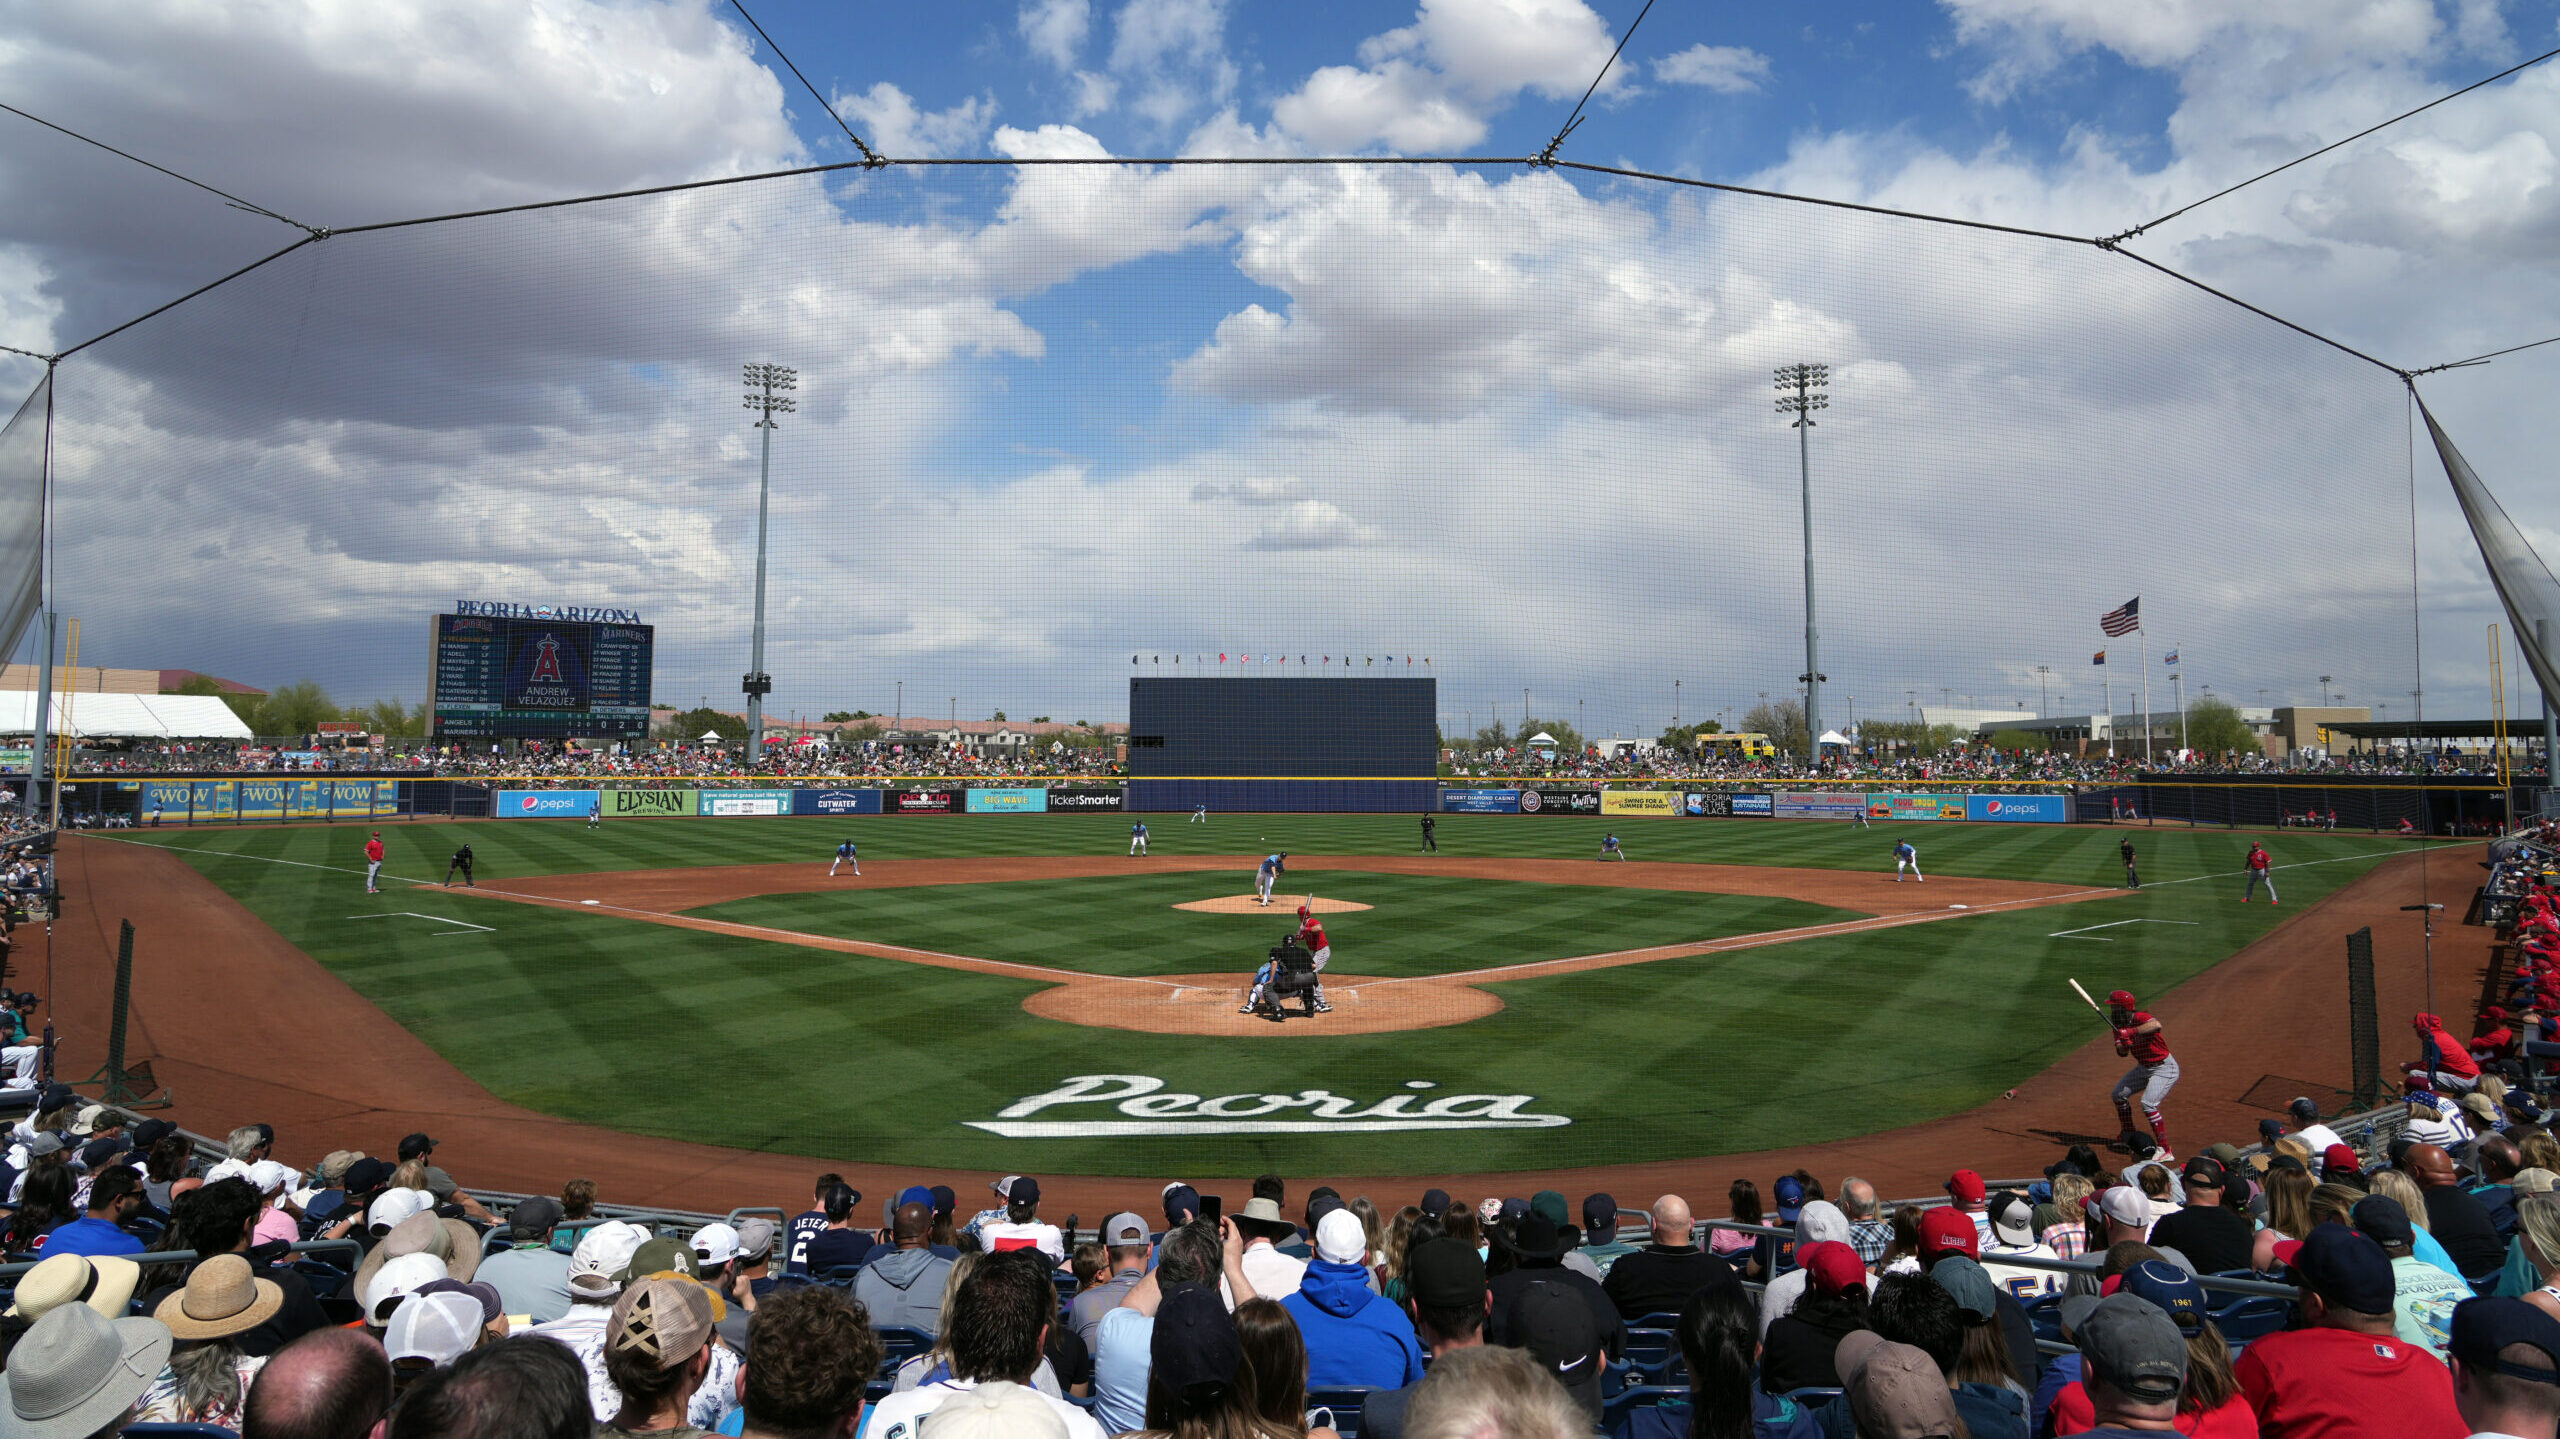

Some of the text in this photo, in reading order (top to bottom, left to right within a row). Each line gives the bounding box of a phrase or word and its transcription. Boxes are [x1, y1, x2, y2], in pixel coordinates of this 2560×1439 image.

[456, 600, 641, 625] PEORIA ARIZONA
[602, 629, 646, 643] MARINERS
[526, 687, 569, 696] ANDREW
[519, 696, 575, 705] VELAZQUEZ
[601, 720, 643, 729] 0 2 0
[151, 788, 209, 803] WOW
[242, 787, 295, 801] WOW
[984, 796, 1030, 804] BIG WAVE
[1049, 794, 1120, 805] TicketSmarter
[541, 798, 574, 810] pepsi
[617, 791, 683, 812] ELYSIAN
[818, 800, 857, 808] CUTWATER
[633, 806, 666, 815] BREWING
[2005, 804, 2040, 815] pepsi
[997, 1074, 1572, 1127] Peoria
[795, 1218, 829, 1231] JETER
[1941, 1233, 1966, 1246] ANGELS
[791, 1231, 816, 1264] 2
[2172, 1299, 2192, 1307] 1961
